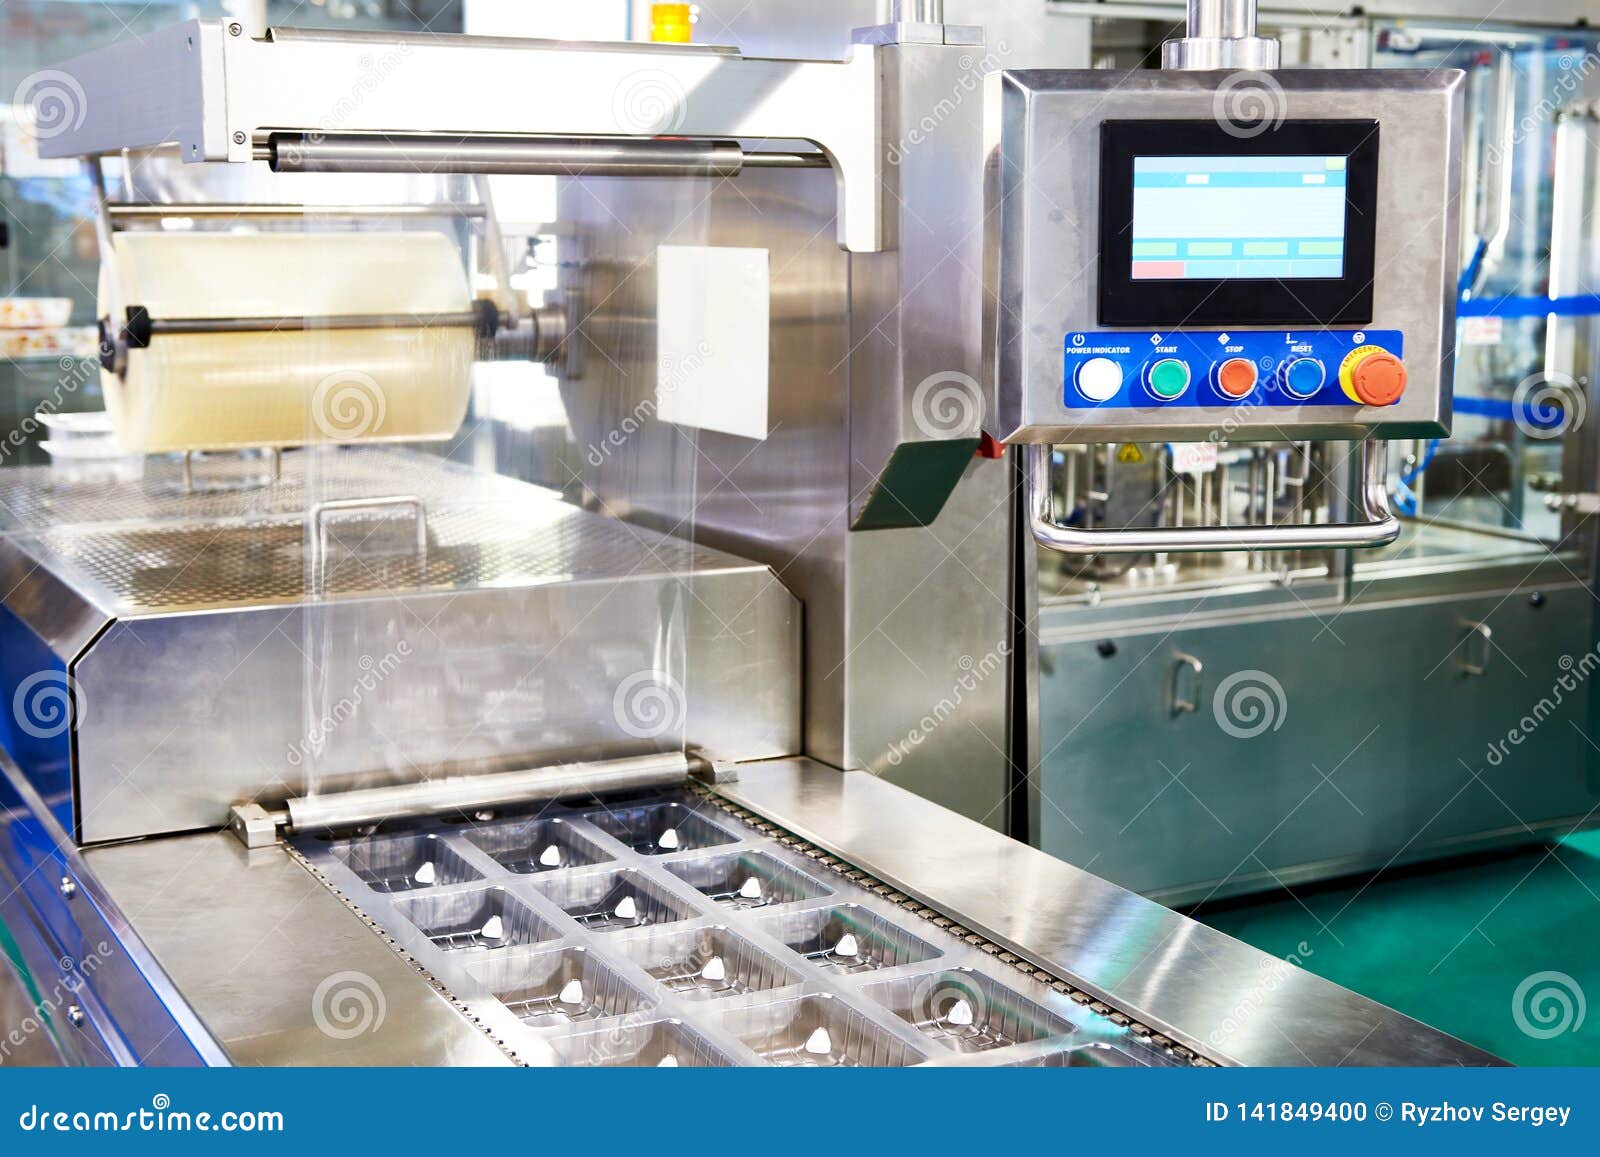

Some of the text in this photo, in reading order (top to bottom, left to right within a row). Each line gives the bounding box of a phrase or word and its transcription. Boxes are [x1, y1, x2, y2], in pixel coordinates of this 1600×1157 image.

[1066, 346, 1131, 354] POWER INDICATOR
[1155, 346, 1178, 354] START
[1225, 345, 1244, 353] STOP
[1290, 345, 1313, 353] RESET
